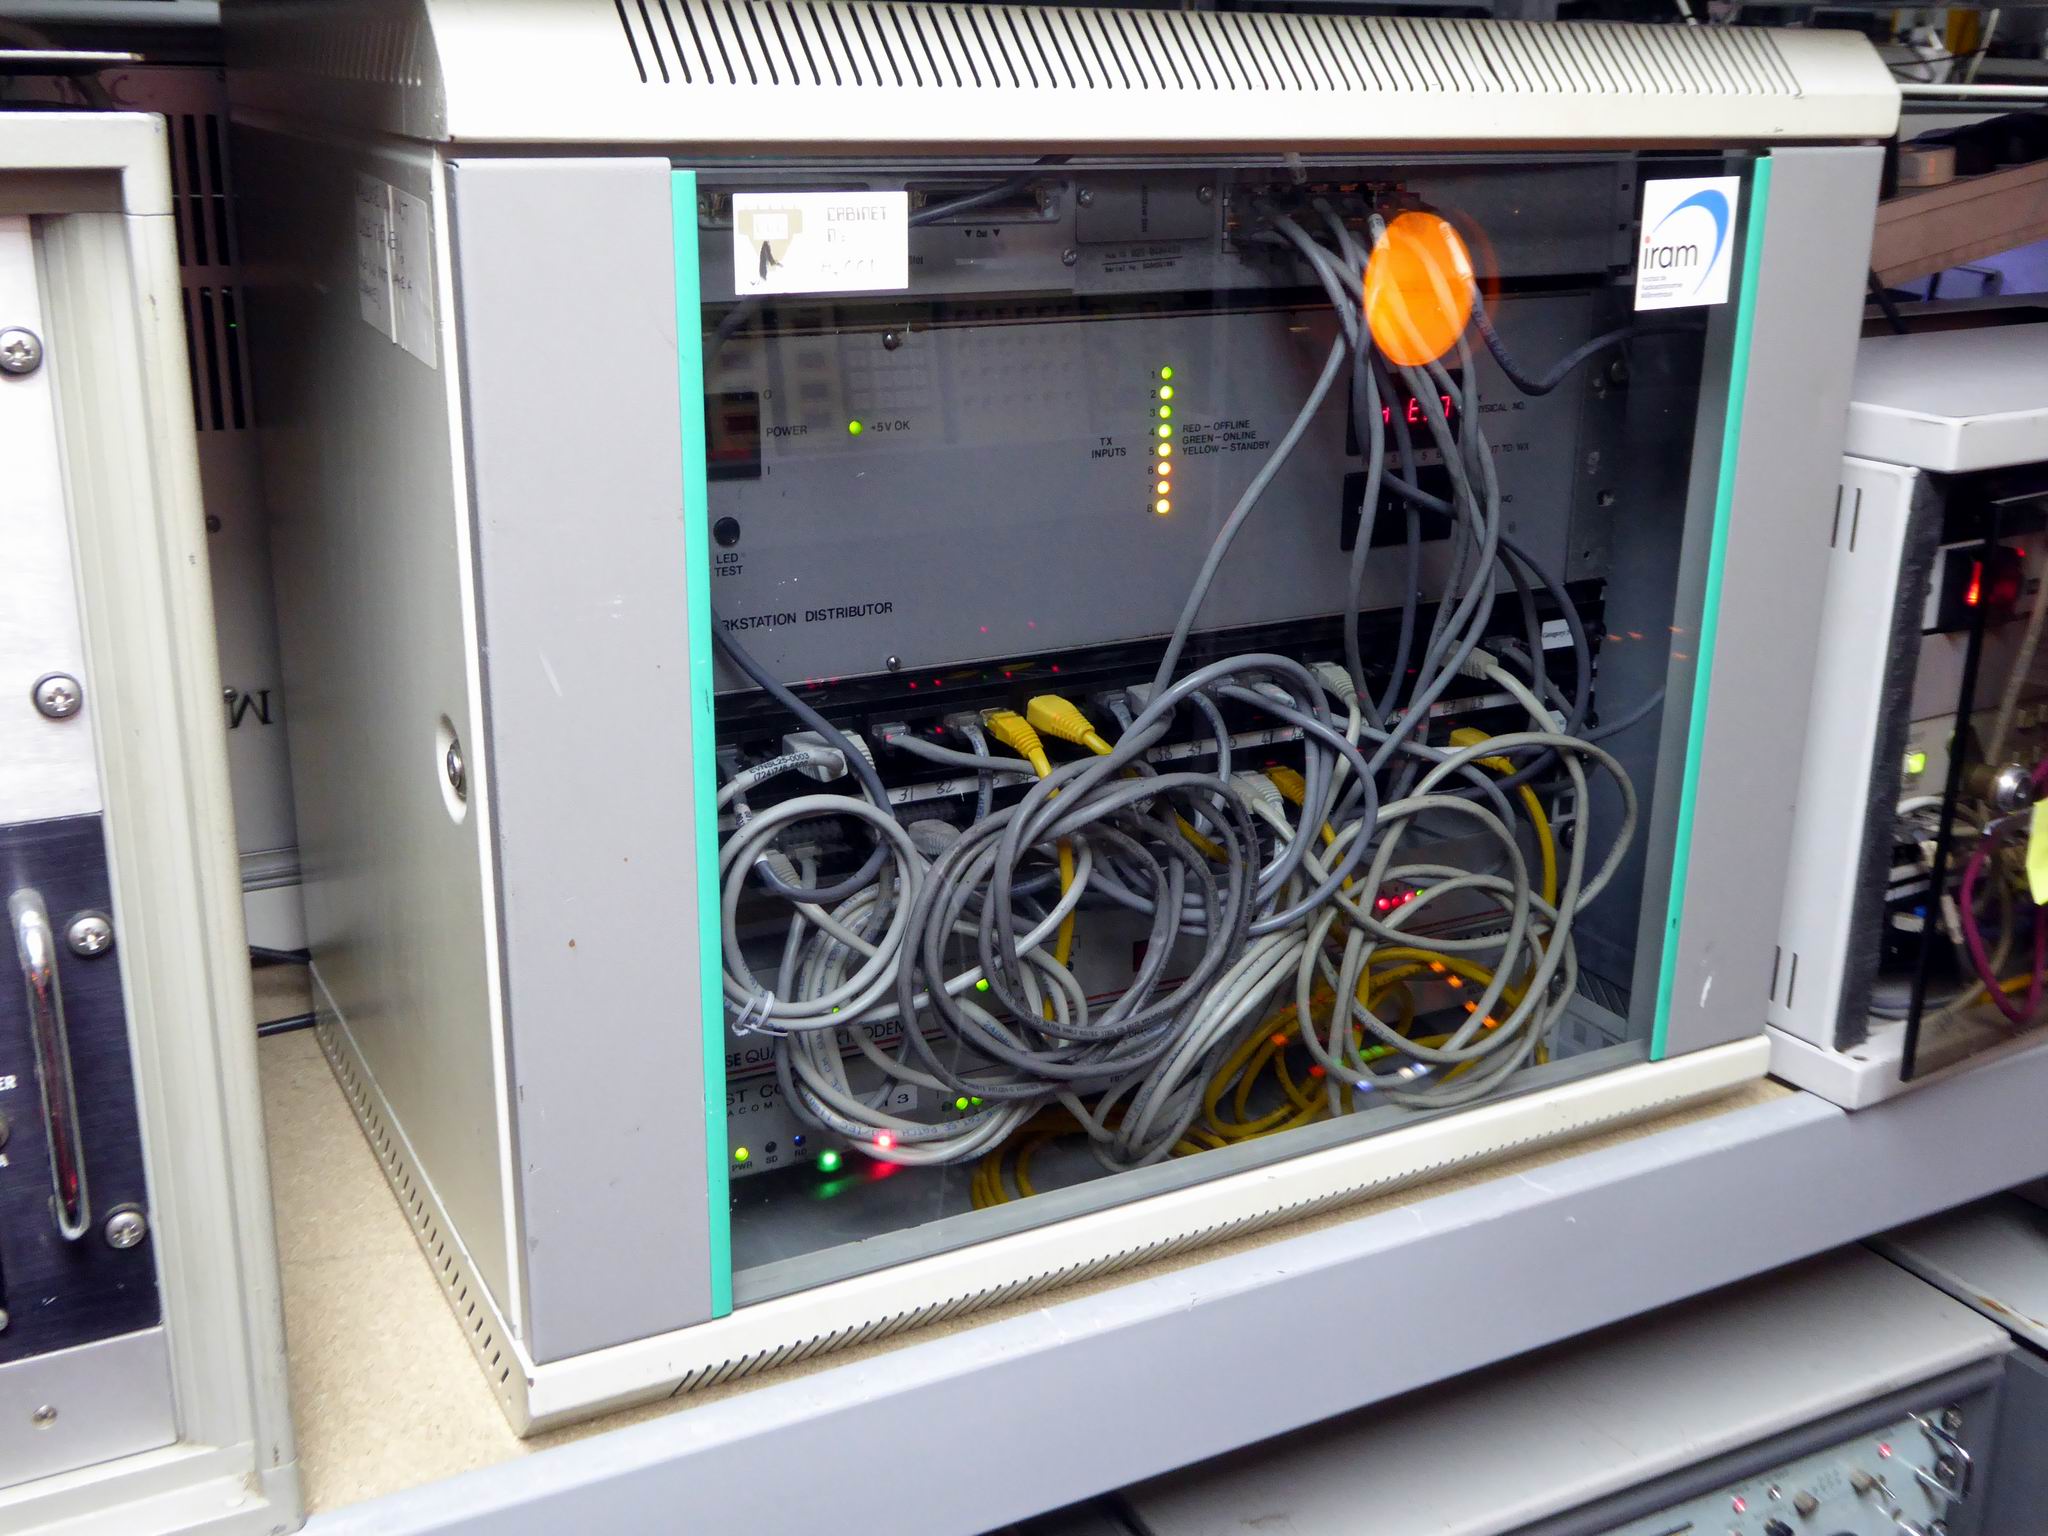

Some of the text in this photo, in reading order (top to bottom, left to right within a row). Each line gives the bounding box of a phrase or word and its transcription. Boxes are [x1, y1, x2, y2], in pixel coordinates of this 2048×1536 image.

[1643, 235, 1698, 270] iram
[766, 424, 808, 438] POWER
[1182, 419, 1250, 433] RED OFFLINE
[1100, 437, 1112, 446] TX
[1182, 430, 1257, 445] GREEN ONLINE
[1091, 447, 1127, 459] INPUTS
[1183, 440, 1270, 455] YELLOW STANDBY
[716, 553, 738, 564] LED
[714, 565, 743, 577] TEST
[805, 602, 893, 622] DISTRIBUTOR
